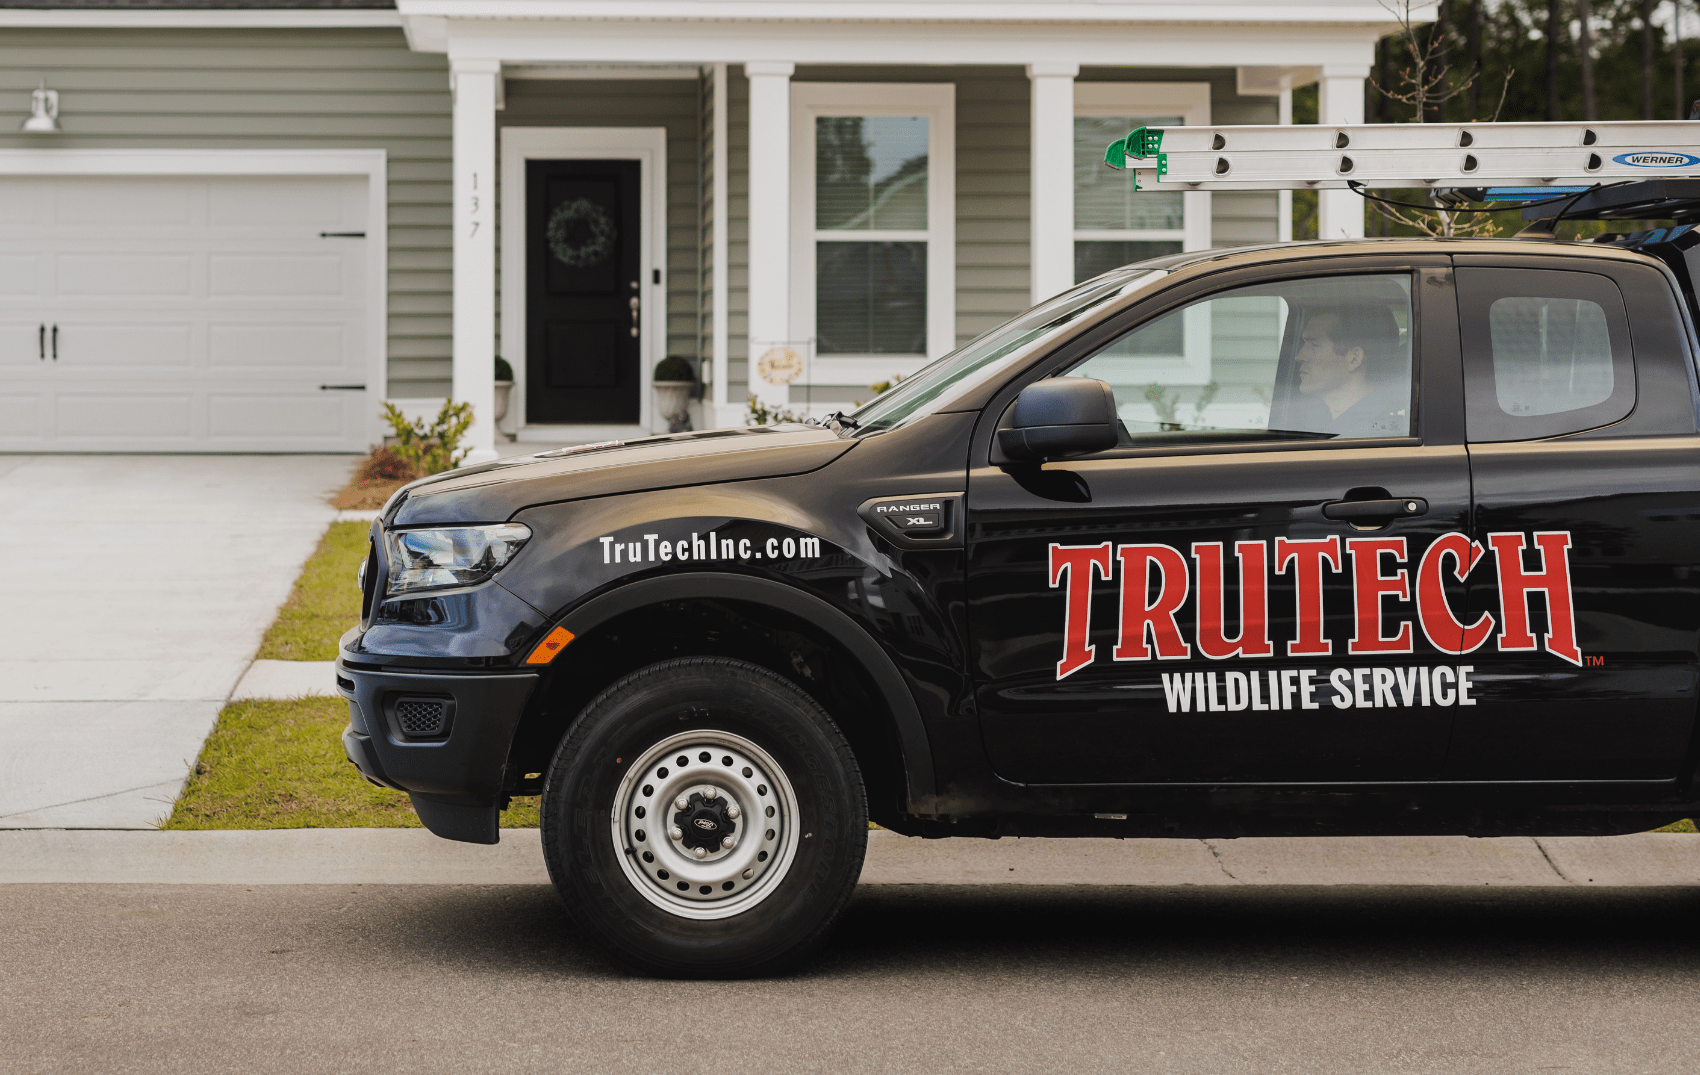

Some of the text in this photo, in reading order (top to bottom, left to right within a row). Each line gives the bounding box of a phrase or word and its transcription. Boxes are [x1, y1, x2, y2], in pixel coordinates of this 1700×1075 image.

[1631, 156, 1684, 164] WERNER
[470, 171, 480, 239] 137
[876, 503, 940, 512] RANGER
[906, 517, 933, 525] XL
[599, 531, 821, 564] TruTechInc.com
[1048, 530, 1604, 681] TRUTECH TM
[1161, 665, 1477, 713] WILDLIFE SERVICE
[727, 699, 838, 902] BRIDGESTONE
